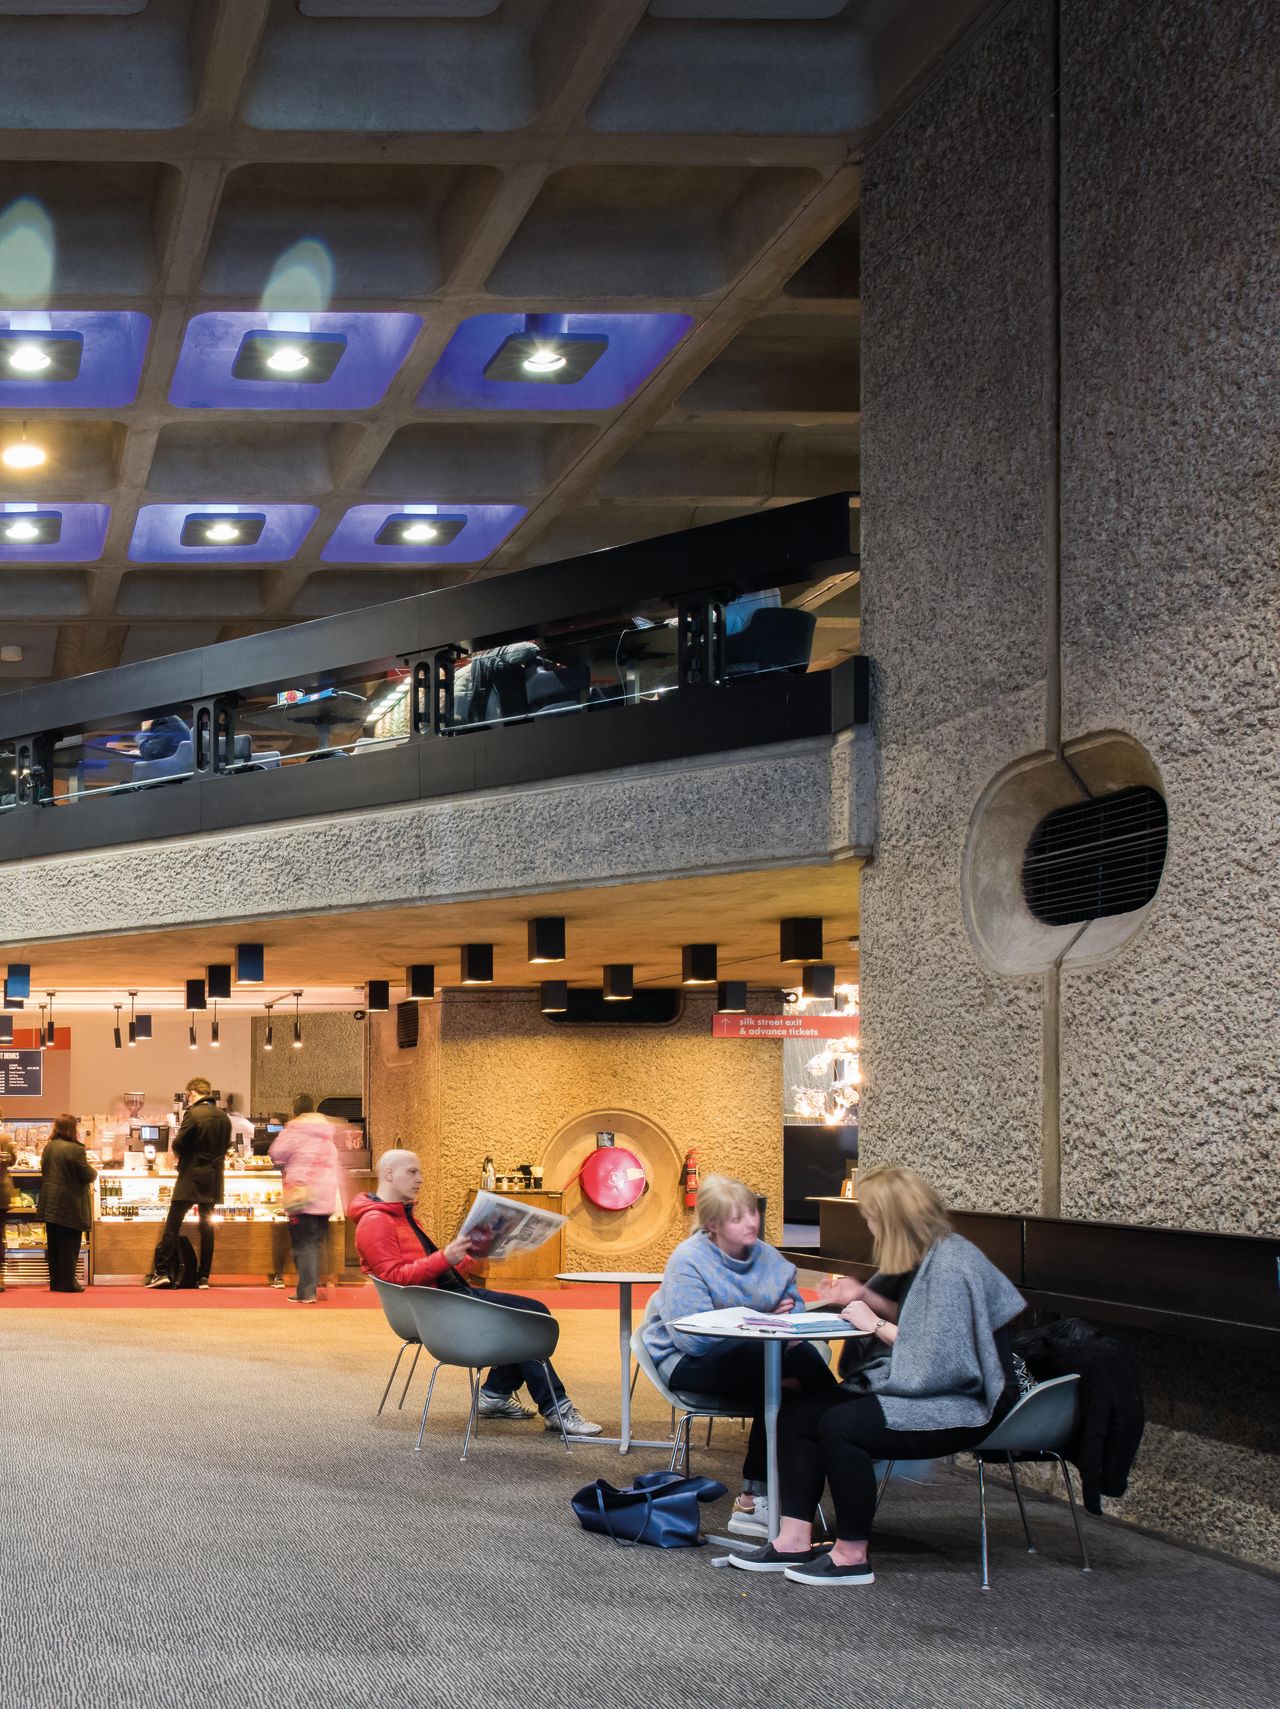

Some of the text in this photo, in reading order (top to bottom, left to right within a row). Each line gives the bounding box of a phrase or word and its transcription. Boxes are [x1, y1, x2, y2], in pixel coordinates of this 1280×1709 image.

[739, 1017, 802, 1026] silk street exit
[739, 1027, 818, 1035] & advance tickets
